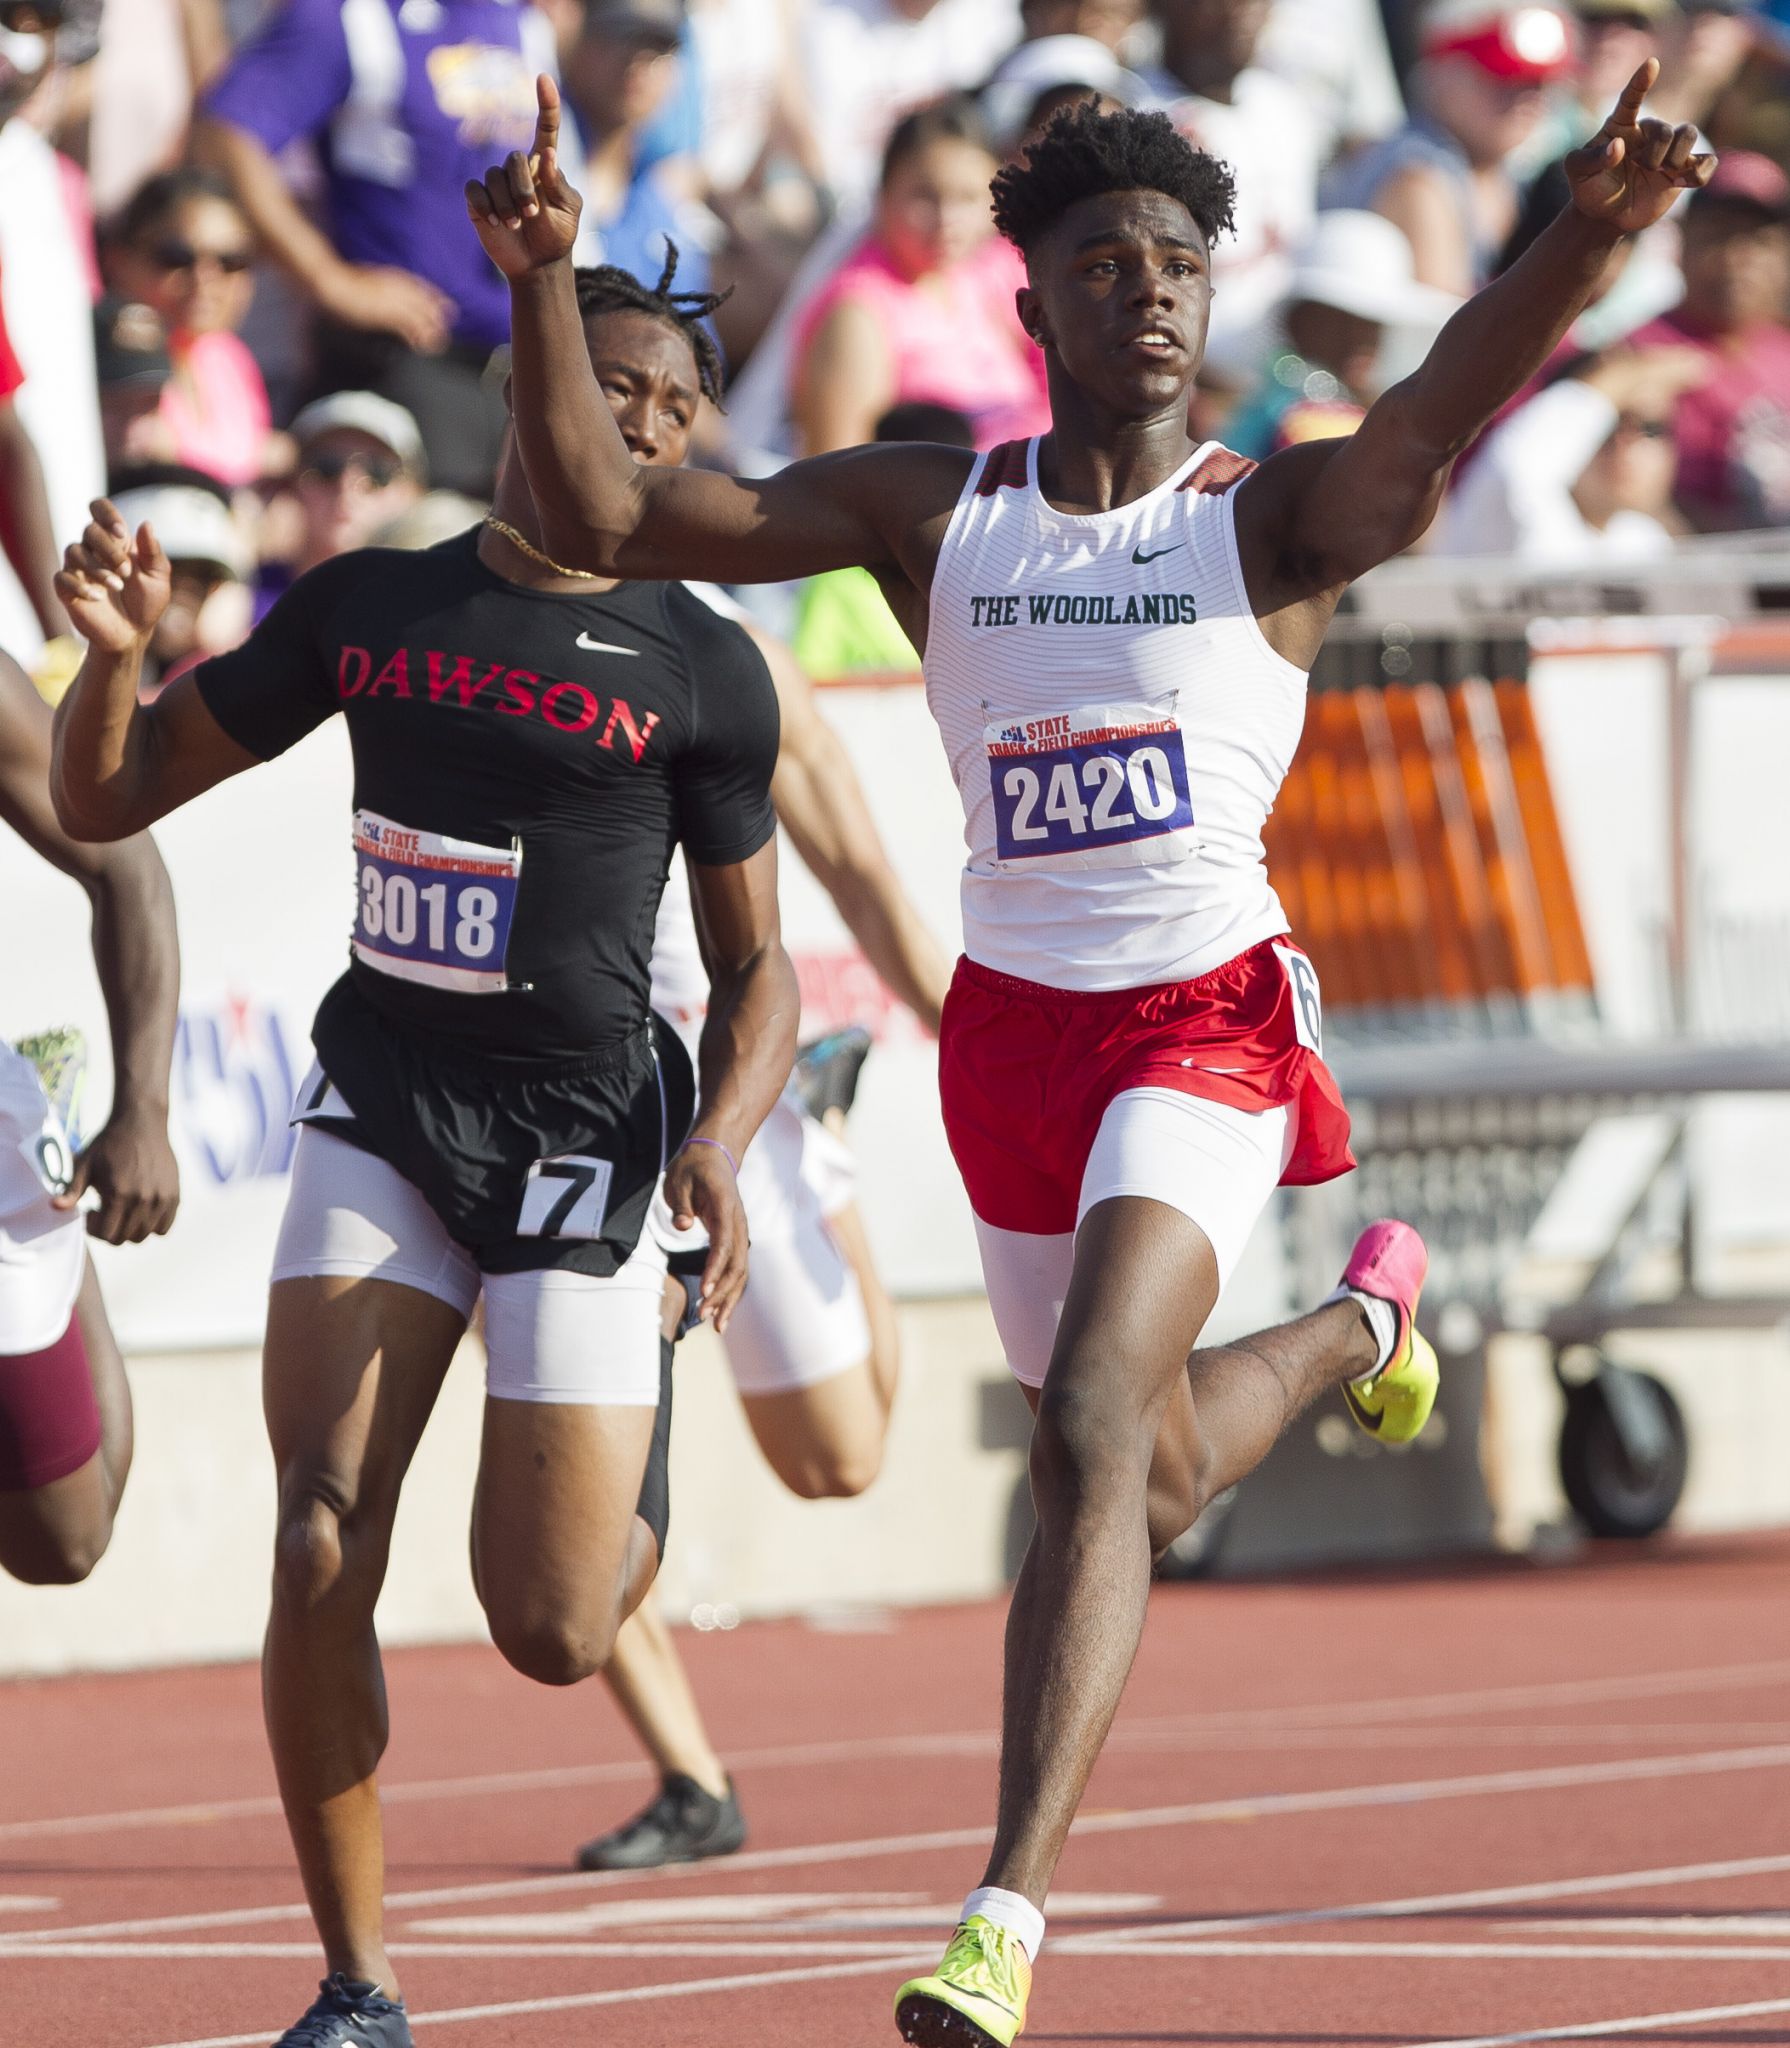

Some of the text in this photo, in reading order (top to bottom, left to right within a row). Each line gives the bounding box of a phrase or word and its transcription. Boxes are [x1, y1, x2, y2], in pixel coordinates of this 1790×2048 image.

[970, 594, 1197, 627] THE WOODLANDS
[338, 646, 661, 764] DAWSON
[1026, 714, 1071, 741] STATE
[987, 717, 1177, 757] TRACK & FIELD CHAMPIONSHIPS
[1003, 746, 1177, 841] 2420
[382, 827, 419, 851] STATE
[388, 847, 414, 865] FIELD
[416, 852, 514, 876] CHAMPIONSHIPS
[361, 864, 498, 958] 3018
[1290, 956, 1319, 1050] 6
[538, 1162, 598, 1237] 7
